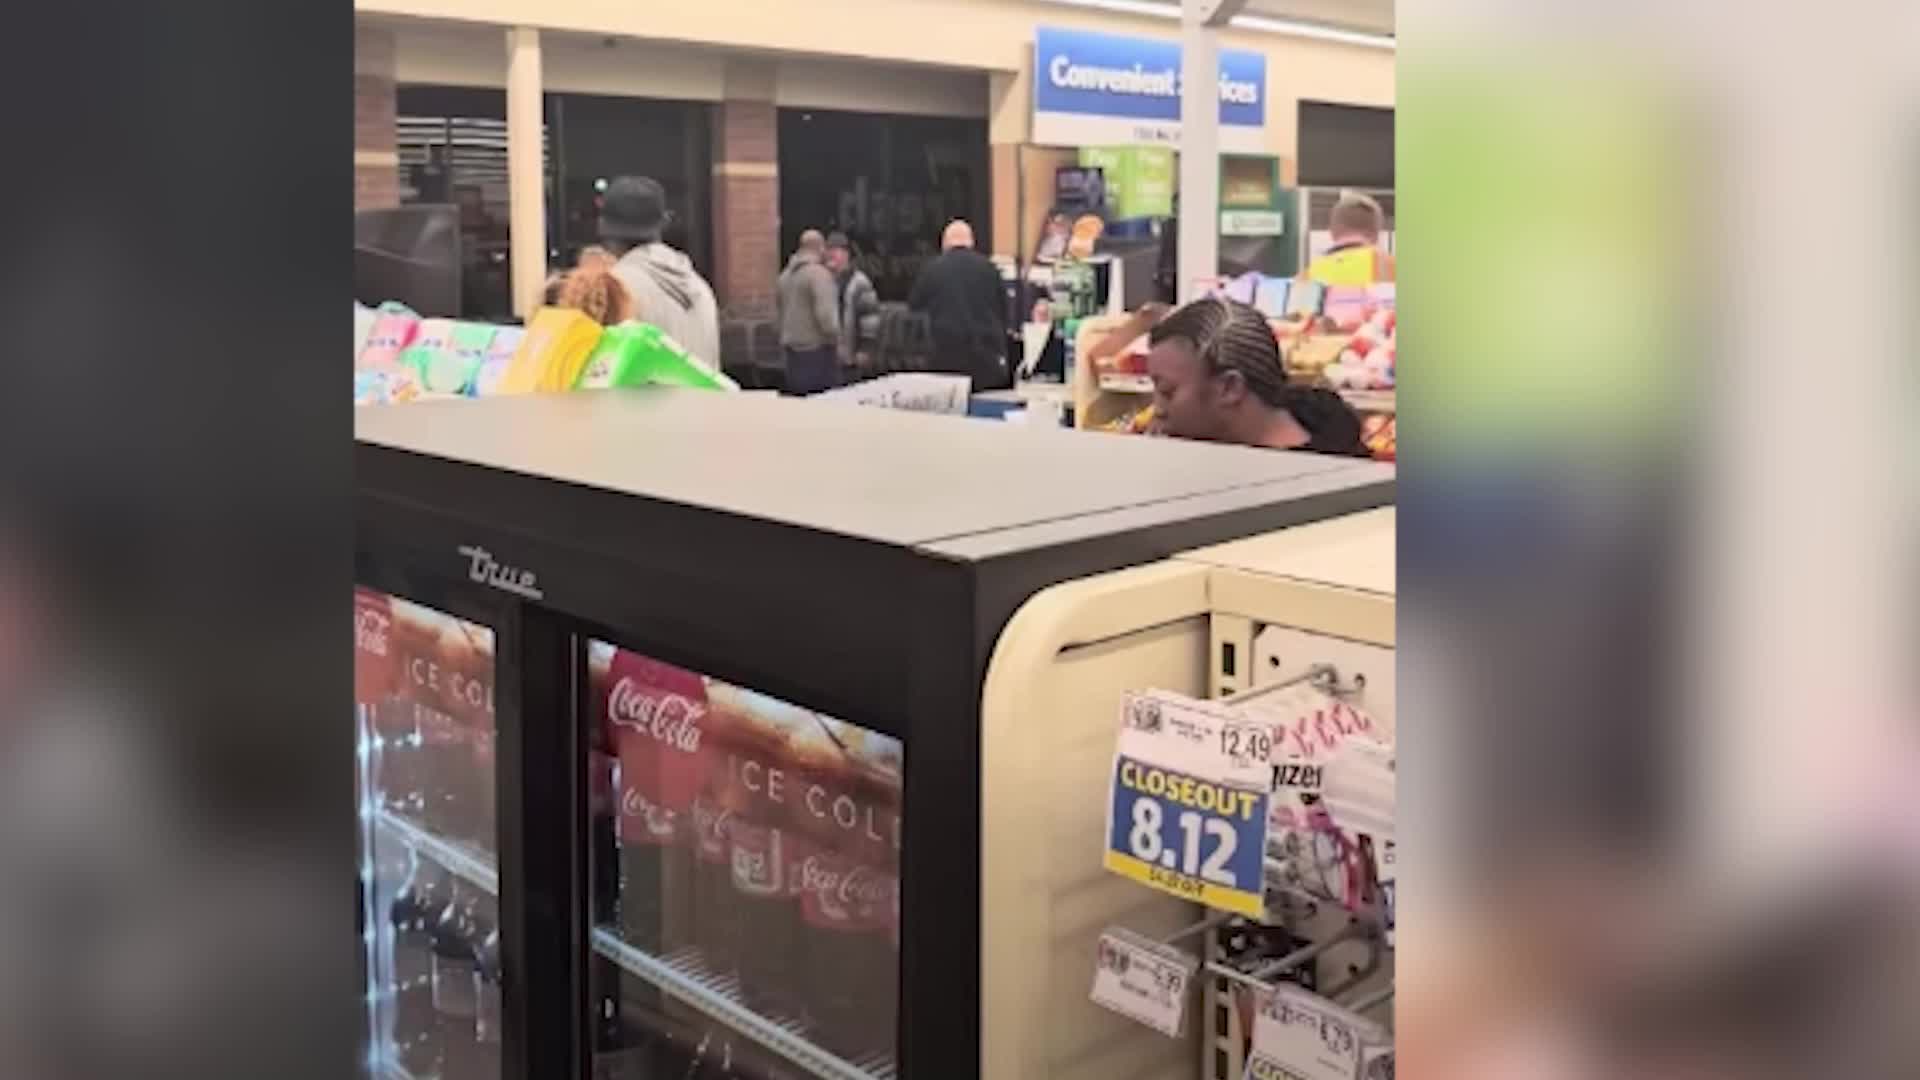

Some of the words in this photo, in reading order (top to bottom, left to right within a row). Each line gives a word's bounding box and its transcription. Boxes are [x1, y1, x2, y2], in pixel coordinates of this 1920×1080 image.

[1049, 54, 1175, 97] Convenient
[1219, 728, 1271, 762] 12.49
[1119, 762, 1259, 822] CLOSEOUT
[1128, 796, 1238, 888] 8.12
